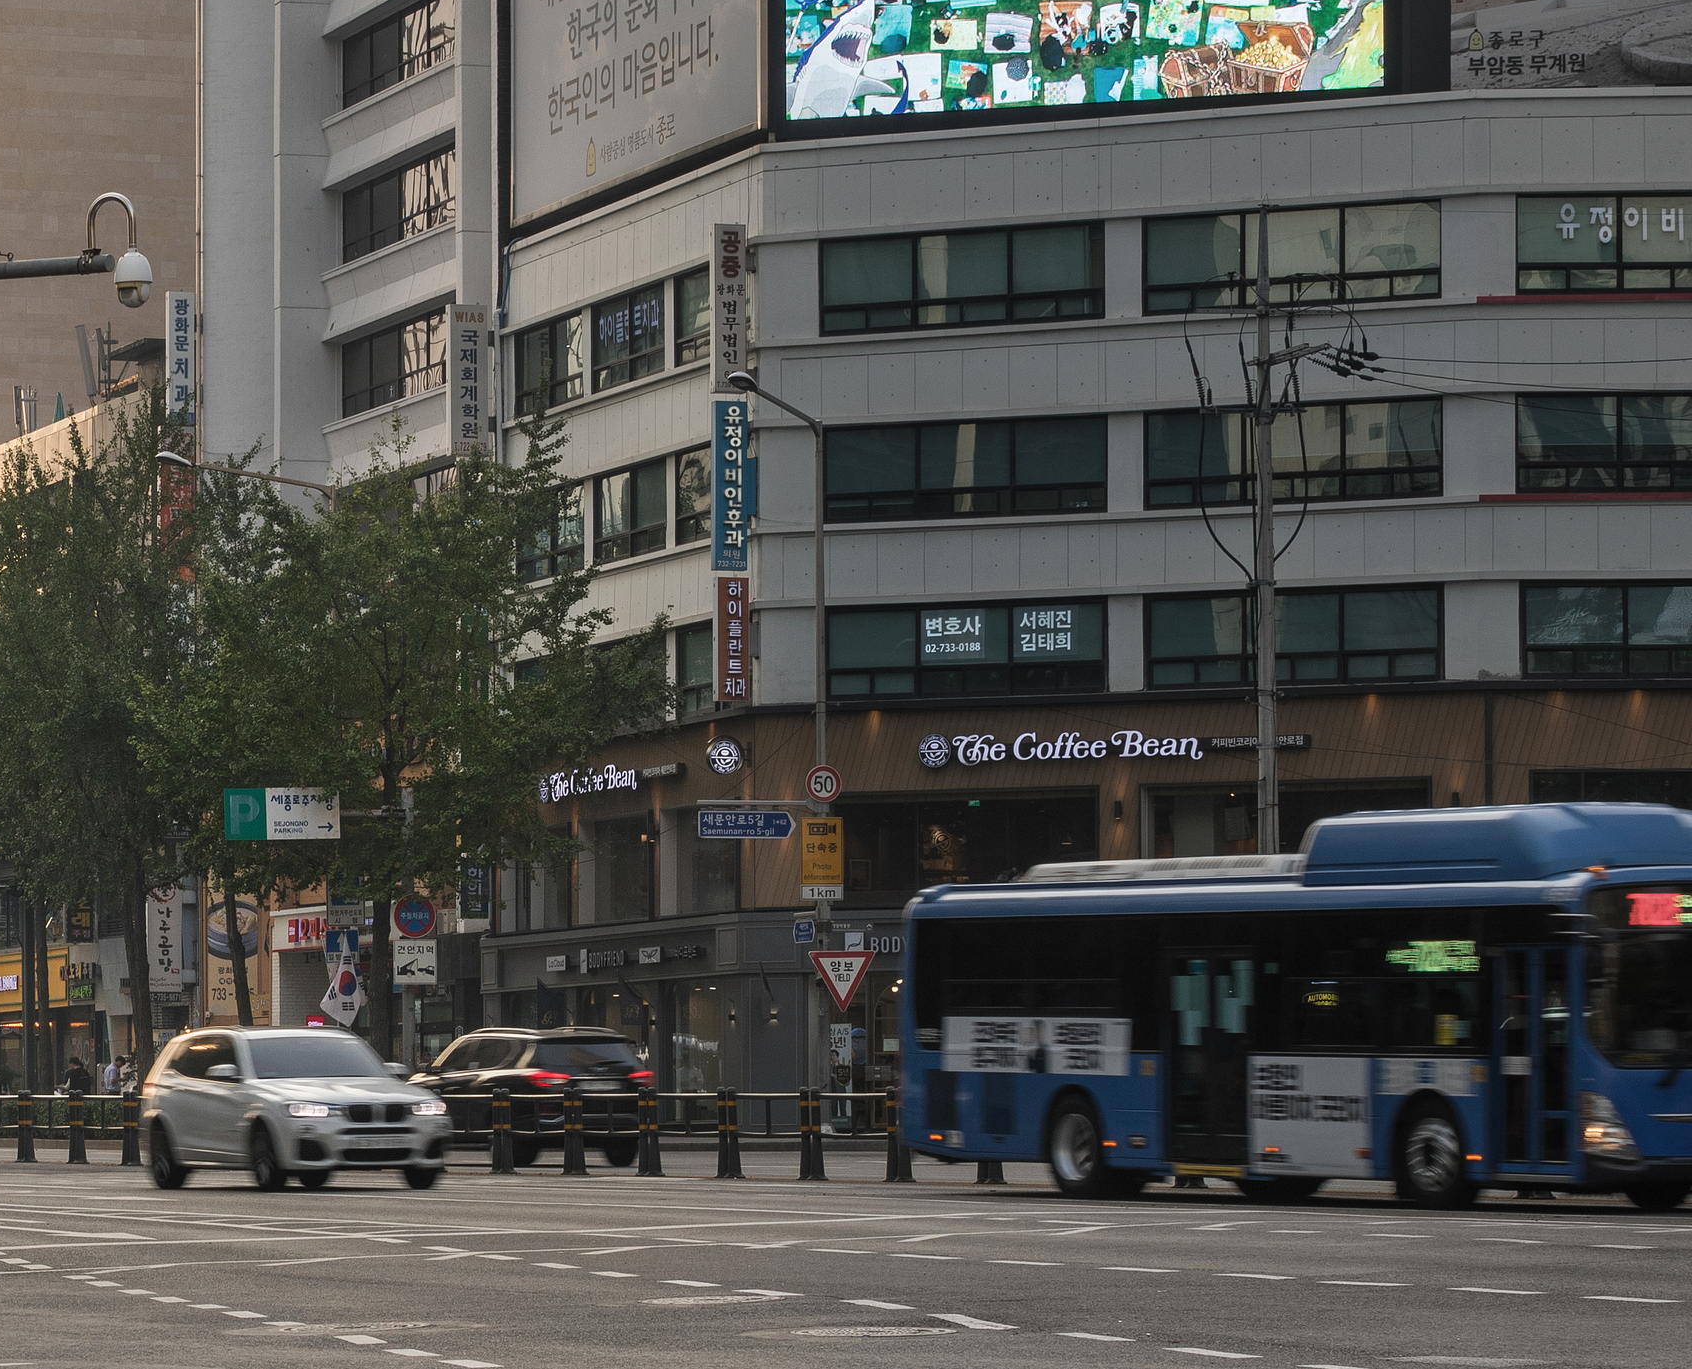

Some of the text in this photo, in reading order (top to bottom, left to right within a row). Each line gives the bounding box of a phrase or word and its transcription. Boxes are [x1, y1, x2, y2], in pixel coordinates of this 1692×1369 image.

[1487, 30, 1546, 50] 종로구
[1467, 52, 1587, 76] 부암동 무계원
[547, 14, 720, 136] 한국인의 마음입니다.
[599, 112, 677, 166] 사람중심 명품도시 종로
[1555, 202, 1685, 244] 유정이비
[720, 230, 742, 279] 공증
[715, 283, 746, 297] 광화문
[174, 298, 190, 352] 광화문
[454, 311, 485, 324] WIAS
[721, 299, 741, 365] 법무법인
[459, 329, 480, 439] 국제회계학원
[724, 405, 744, 549] 유정이비인후과
[717, 559, 747, 569] 732-7231
[722, 549, 741, 560] 의원
[727, 580, 744, 675] 하이플란트
[925, 615, 982, 637] 변호사
[1019, 610, 1072, 630] 서혜진
[925, 642, 981, 653] 02-733-0188
[1019, 632, 1072, 652] 김태희
[724, 677, 747, 698] 치과
[952, 734, 1006, 766] The
[1013, 732, 1107, 760] Coffee
[1111, 730, 1204, 760] Bean
[603, 764, 637, 790] Bean
[813, 776, 834, 793] 50
[273, 820, 309, 828] SEJONGNO
[702, 814, 764, 826] 새문안로5길
[702, 827, 775, 836] Saemunan-ro 5-gil
[806, 843, 838, 853] 단속중
[812, 863, 832, 871] Photo
[809, 887, 836, 897] 1km
[397, 945, 434, 955] 견인지역
[589, 950, 624, 968] BODYFRIEND
[830, 960, 854, 972] 양보
[833, 973, 850, 982] YIELD
[151, 992, 182, 1001] 2-735-9871
